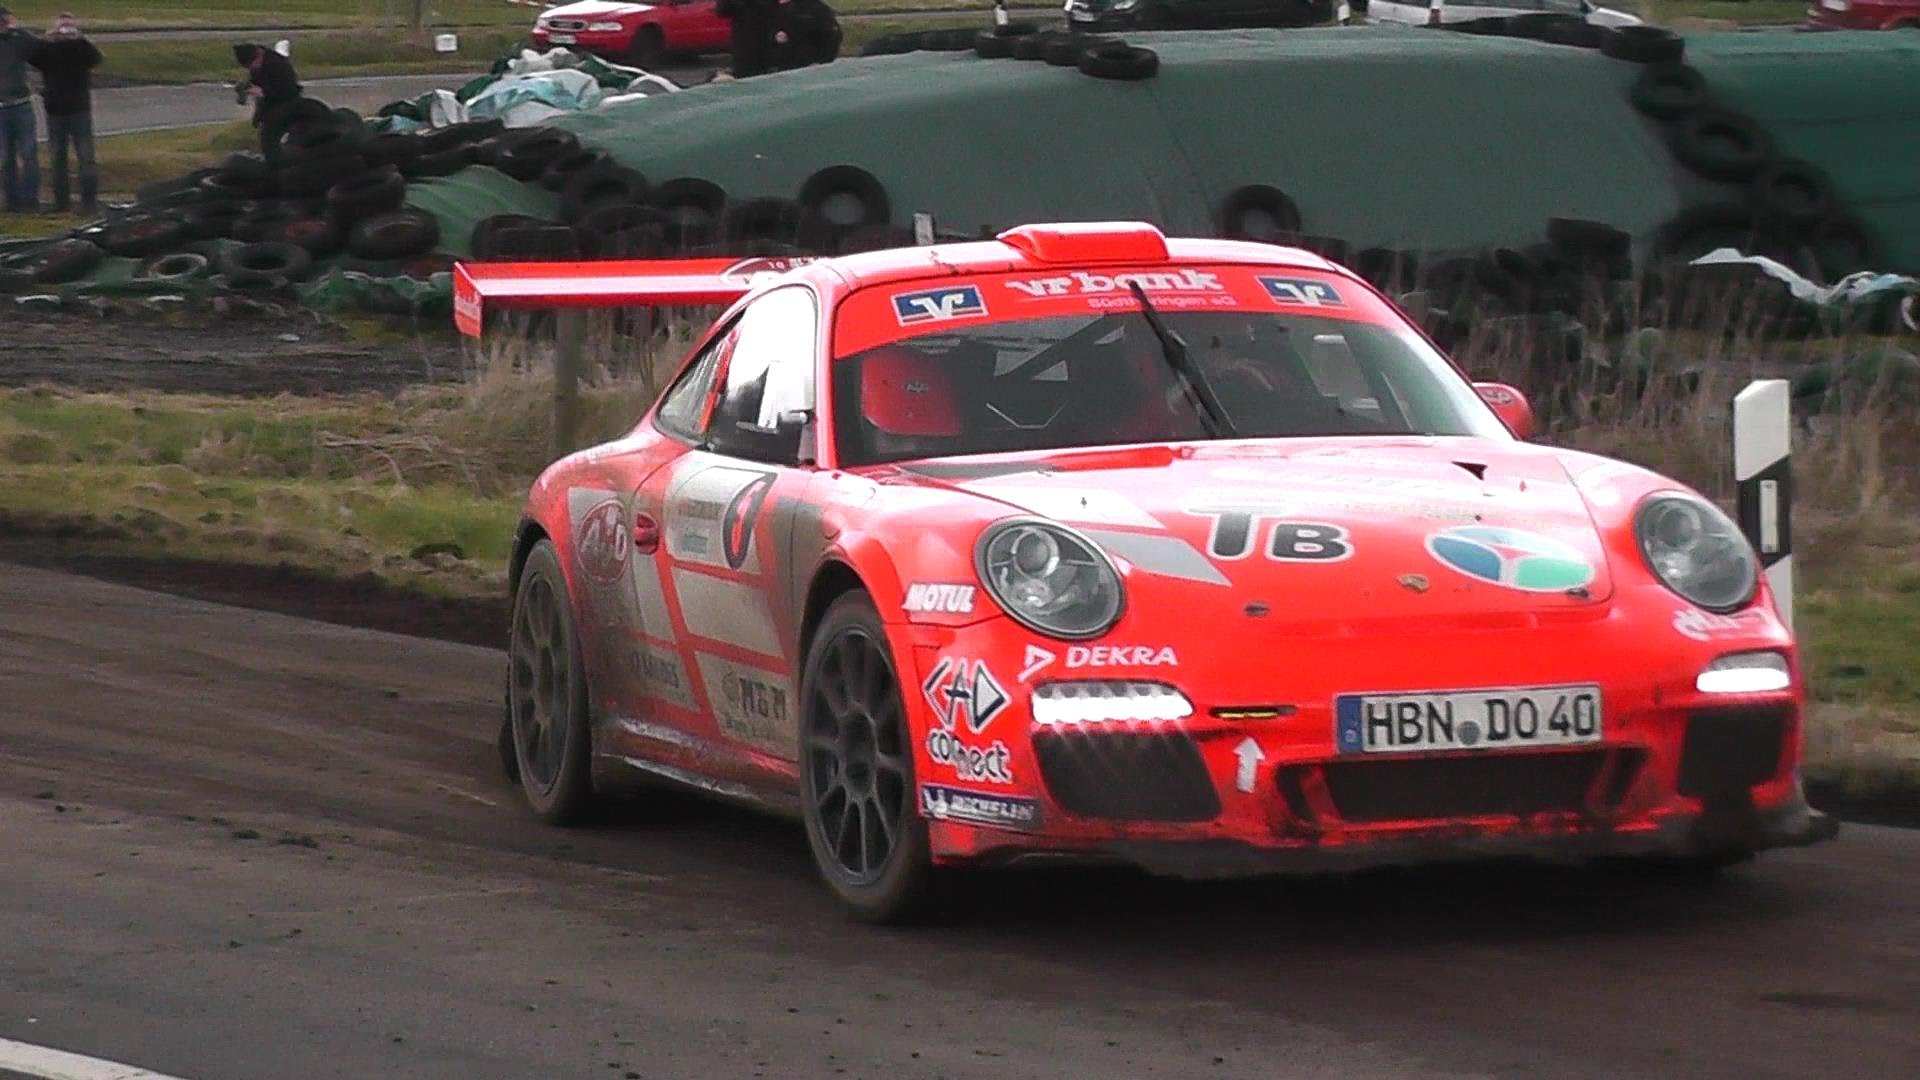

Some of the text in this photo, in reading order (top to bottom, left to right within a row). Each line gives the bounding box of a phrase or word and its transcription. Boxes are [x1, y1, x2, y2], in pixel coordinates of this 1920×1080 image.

[1071, 269, 1224, 292] bank
[1088, 296, 1207, 308] Südthringen
[901, 583, 976, 612] MOTUL
[1066, 646, 1178, 668] DEKRA
[1366, 693, 1596, 746] HBN DO 40
